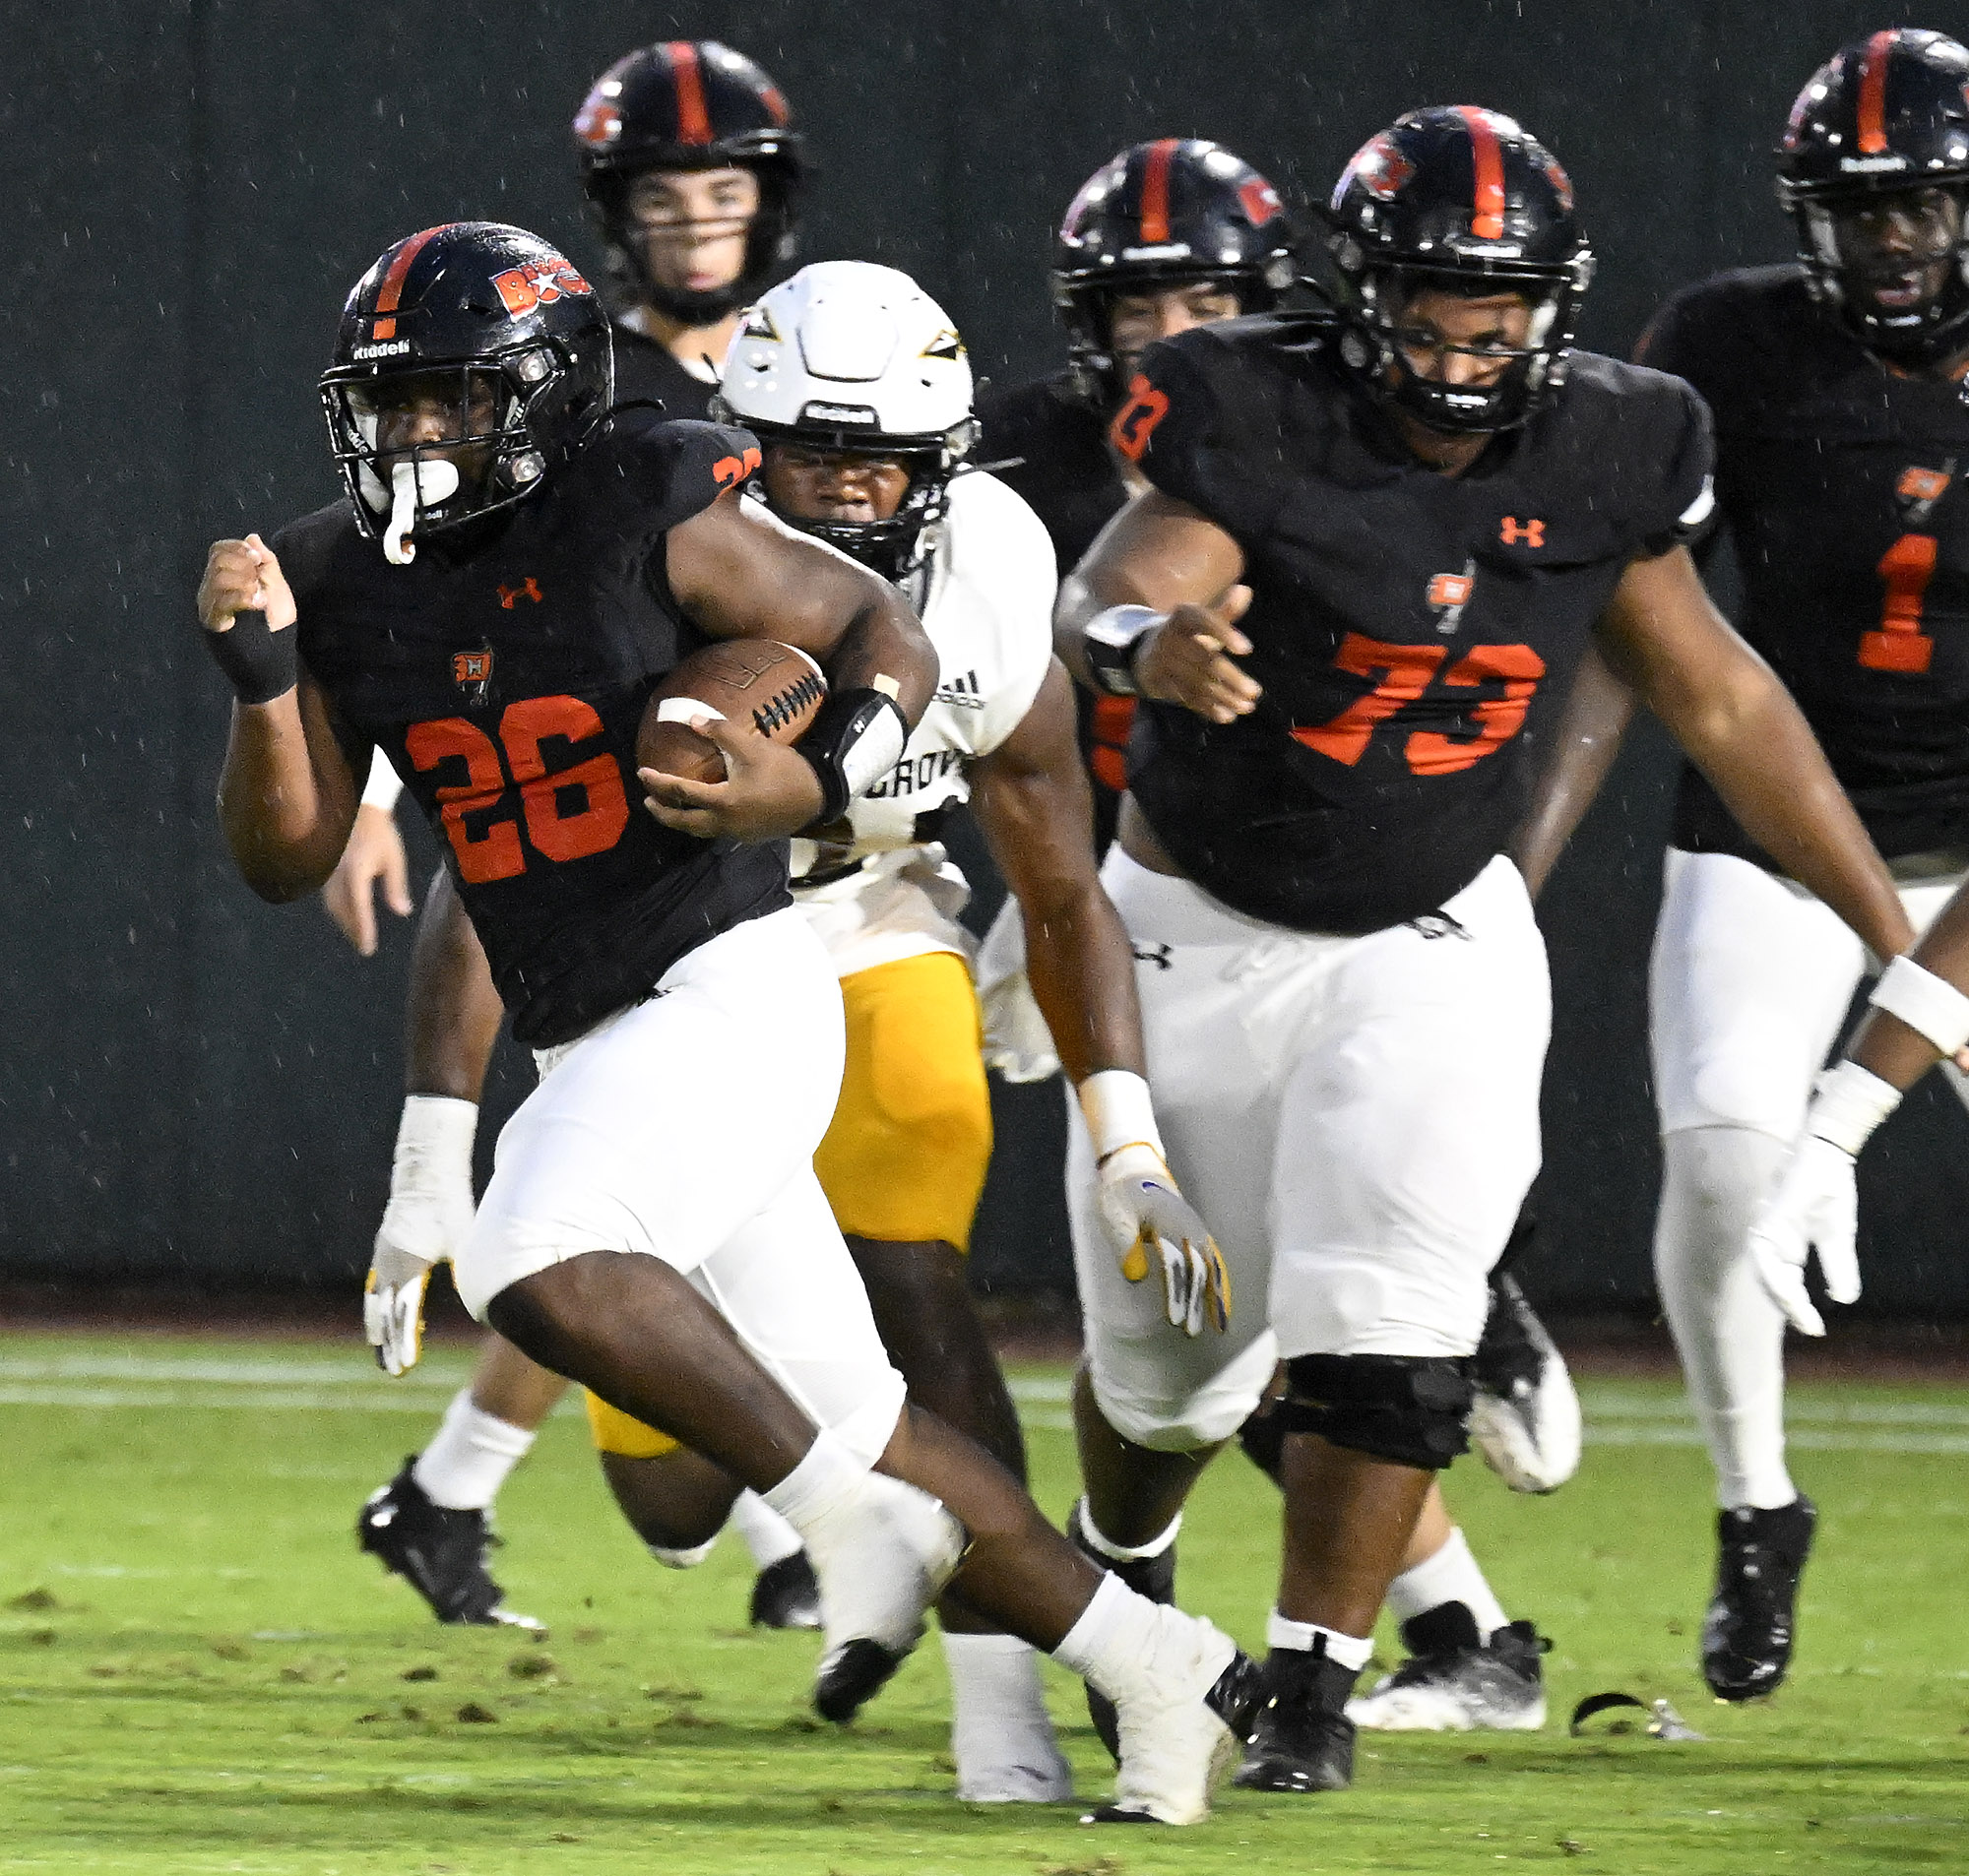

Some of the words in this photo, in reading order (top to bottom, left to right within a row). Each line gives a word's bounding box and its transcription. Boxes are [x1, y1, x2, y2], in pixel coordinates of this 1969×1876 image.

[1857, 534, 1937, 673] 1
[1290, 632, 1546, 776] 73
[406, 694, 629, 884] 26
